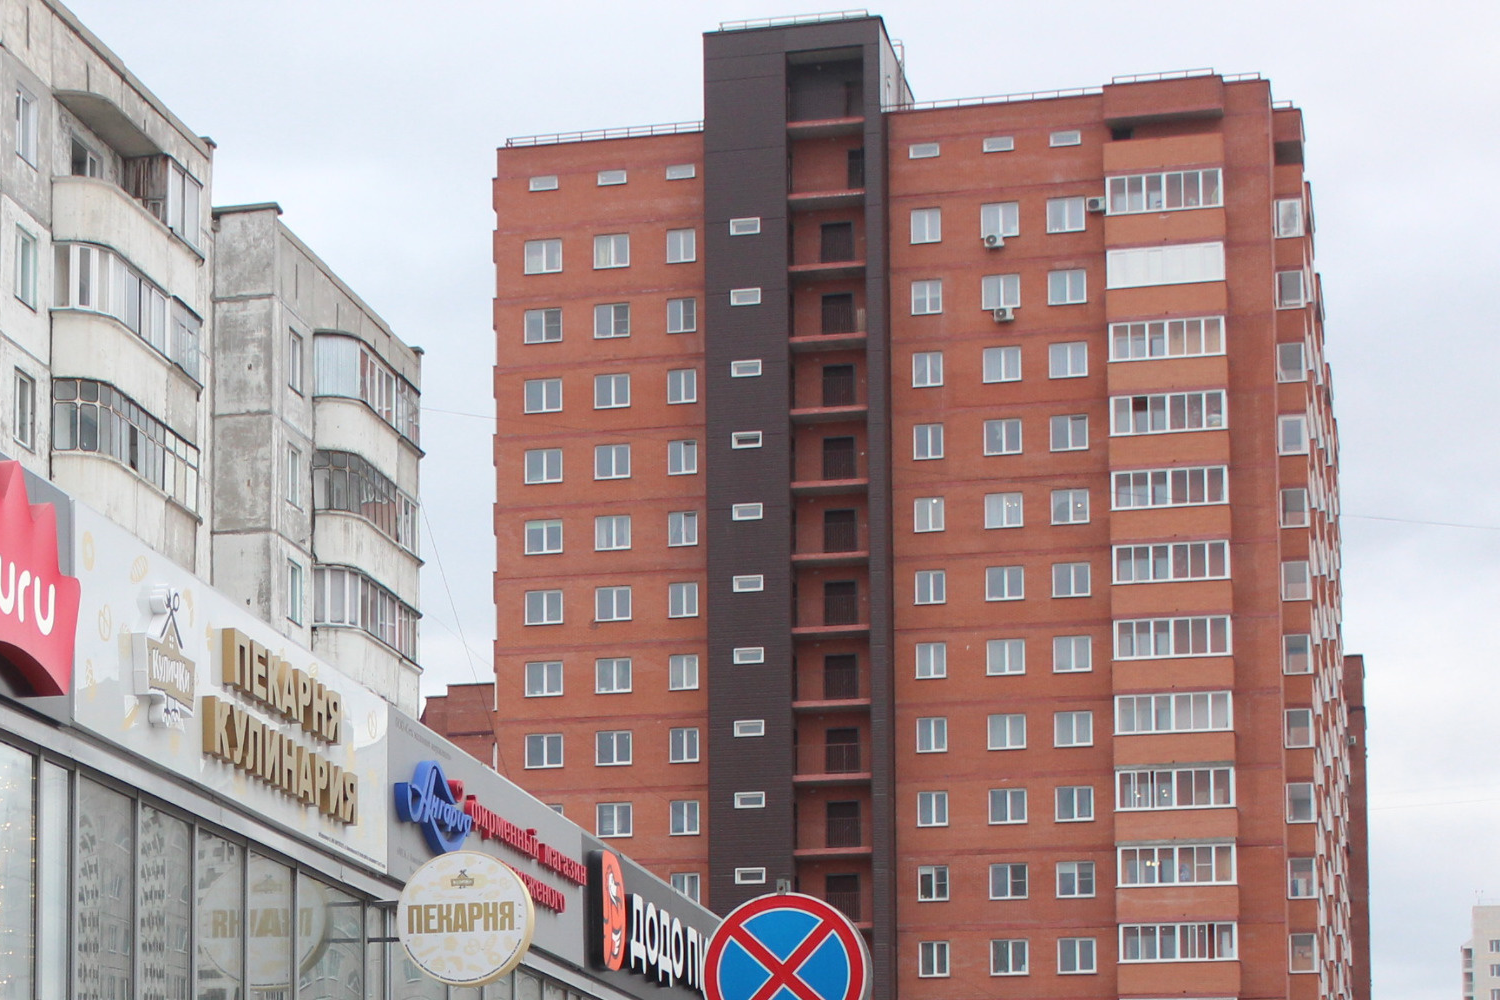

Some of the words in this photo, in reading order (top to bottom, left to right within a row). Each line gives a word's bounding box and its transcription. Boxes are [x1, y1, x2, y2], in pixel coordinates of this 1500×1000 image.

[227, 627, 342, 745] ПЕКАРНЯ
[208, 696, 359, 826] КУЛИНАРИЯ
[543, 846, 588, 888] магазин
[408, 901, 515, 934] ПЕКАРНЯ
[630, 893, 685, 988] ДОДО
